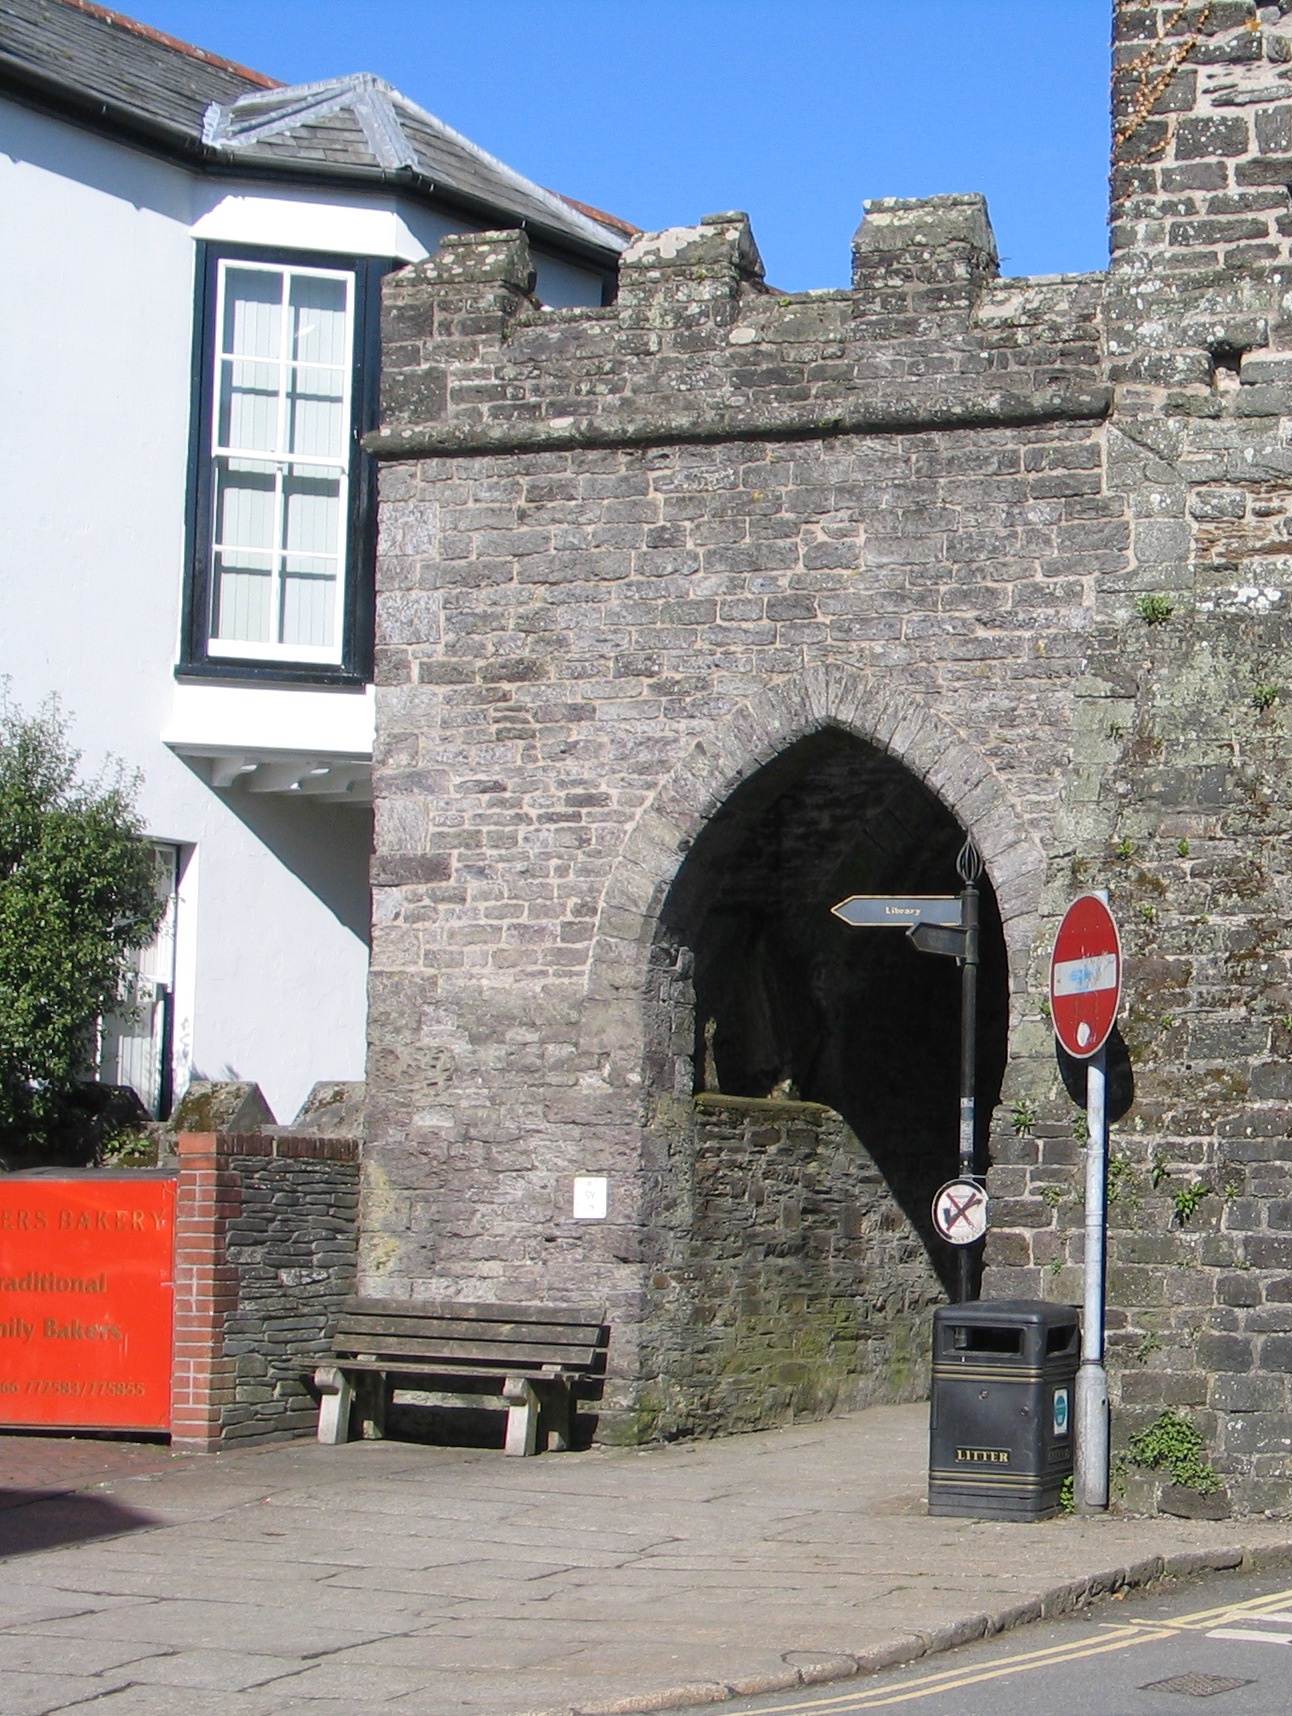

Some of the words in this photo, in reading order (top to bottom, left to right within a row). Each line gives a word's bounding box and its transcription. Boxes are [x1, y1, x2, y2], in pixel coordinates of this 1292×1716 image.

[885, 906, 921, 916] Library
[1, 1209, 47, 1230] ERS
[59, 1208, 166, 1231] BAKERY
[44, 1318, 124, 1341] Bakers
[957, 1449, 1009, 1463] LITTER
